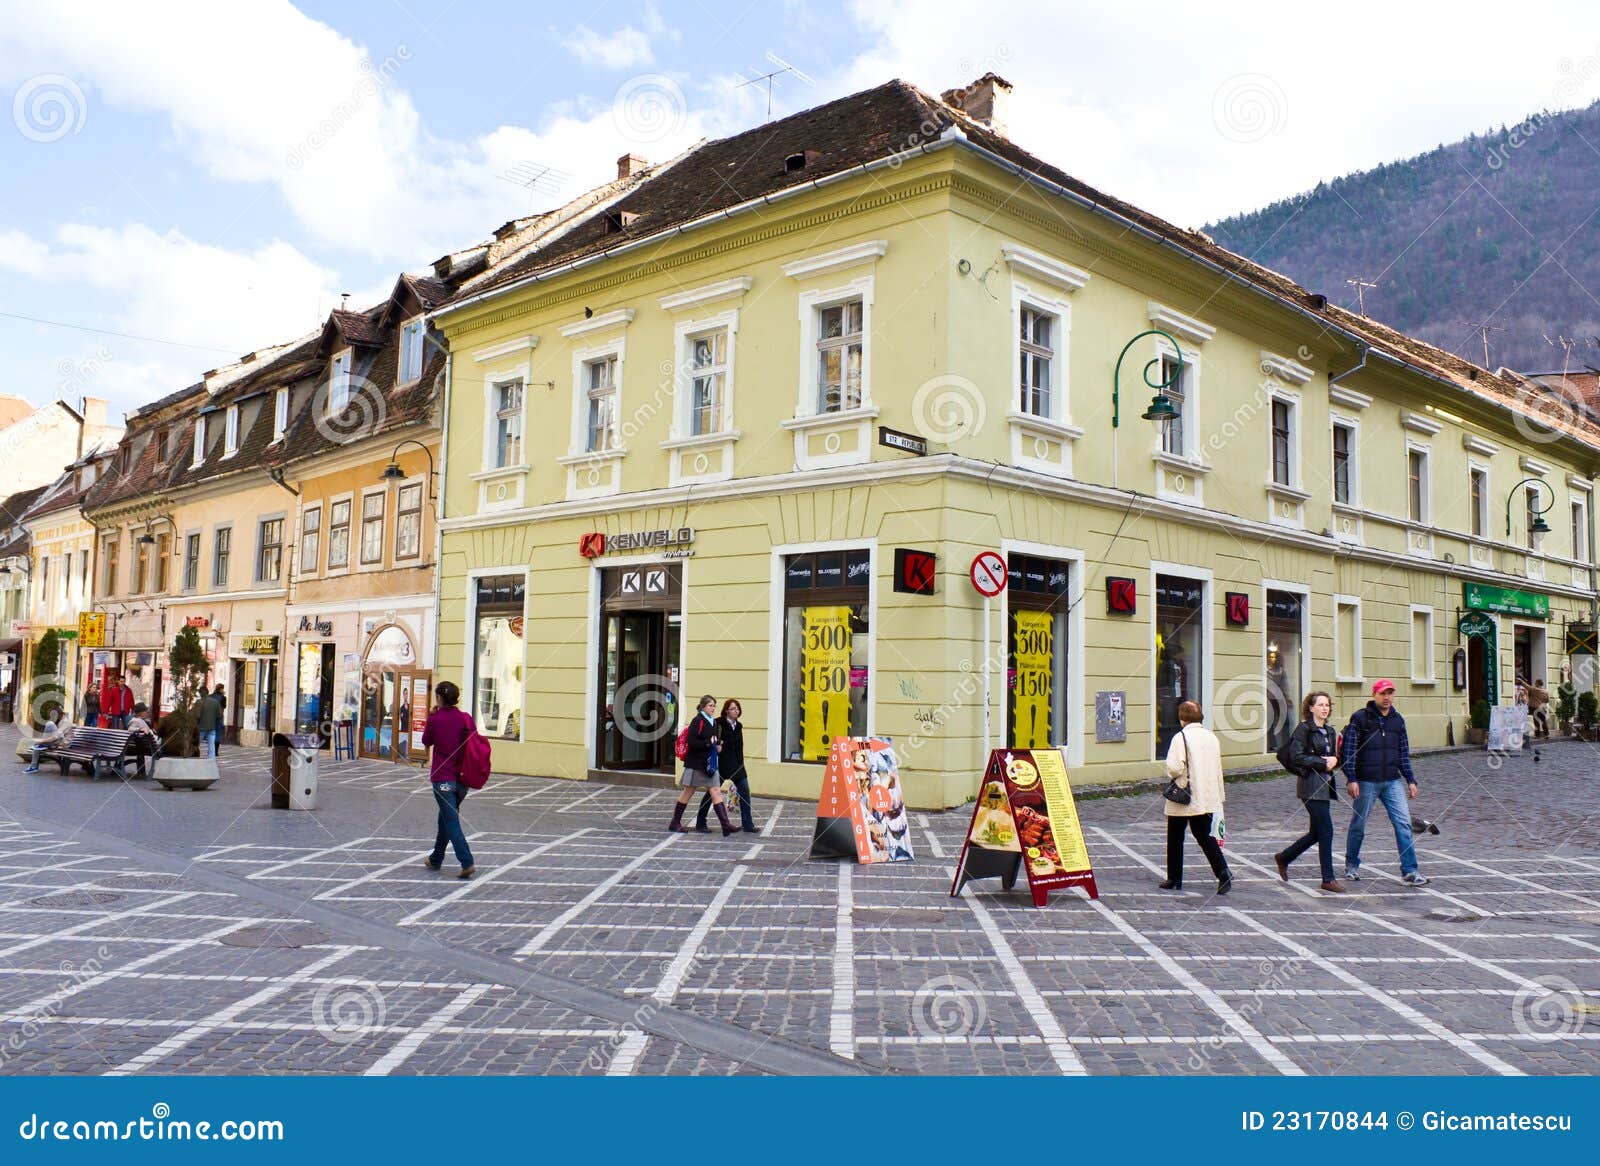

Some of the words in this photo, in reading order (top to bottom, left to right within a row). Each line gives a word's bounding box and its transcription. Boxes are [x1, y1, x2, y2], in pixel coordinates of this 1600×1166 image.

[605, 528, 694, 551] KENVELO
[808, 625, 846, 650] 300
[1020, 629, 1048, 655] 300
[808, 667, 846, 692] 150
[1019, 671, 1047, 697] 150
[841, 742, 864, 851] COVRIGI
[876, 789, 883, 800] 1
